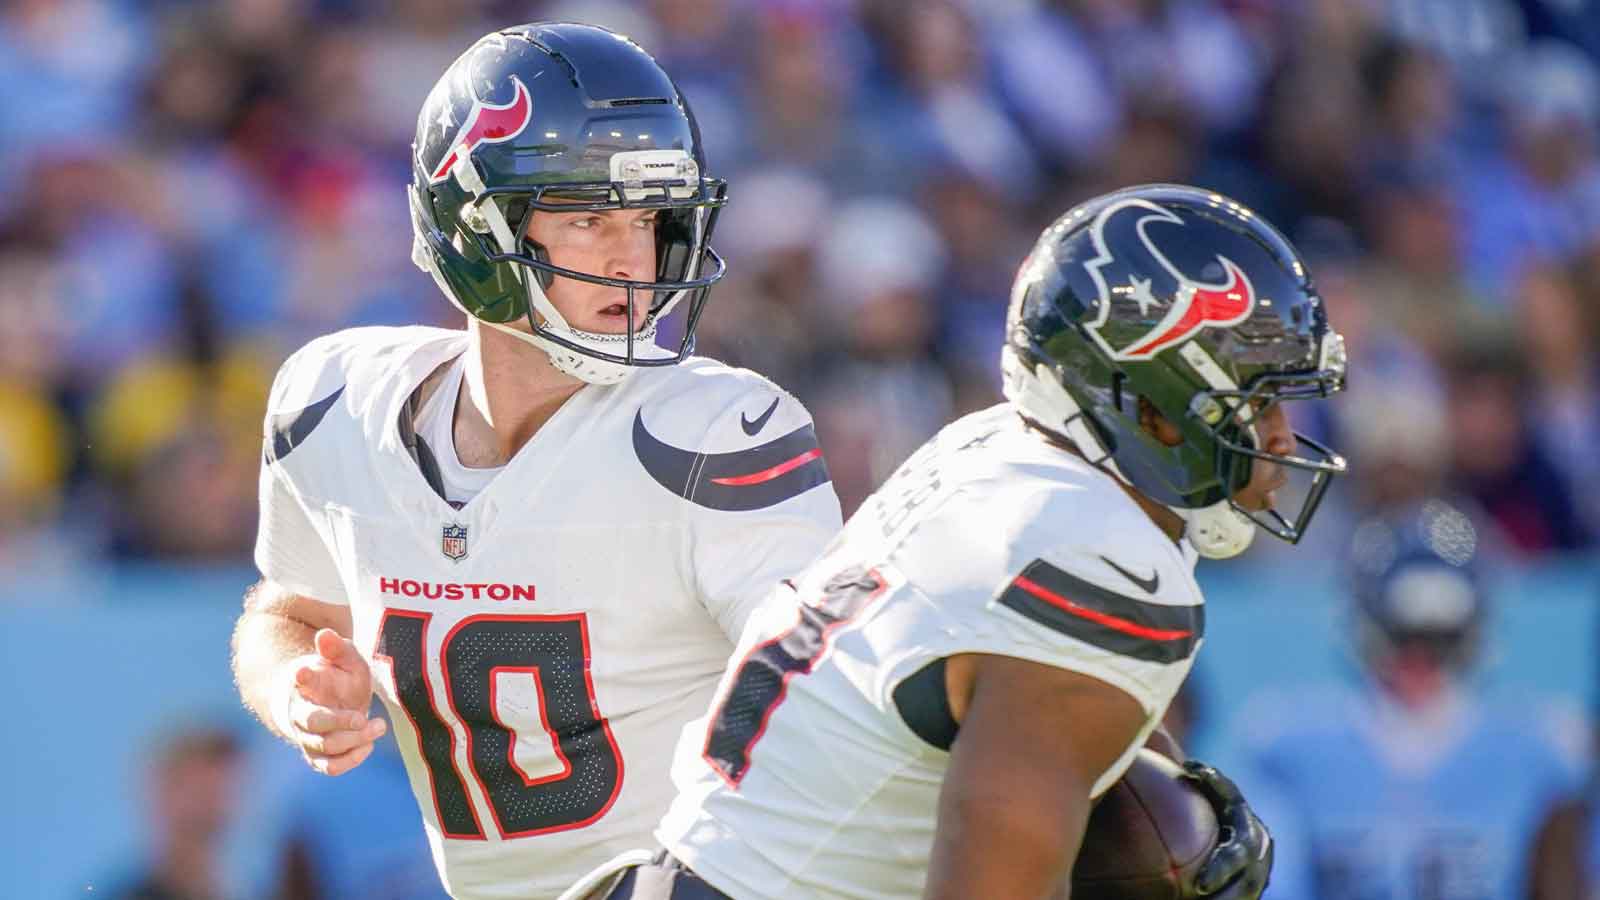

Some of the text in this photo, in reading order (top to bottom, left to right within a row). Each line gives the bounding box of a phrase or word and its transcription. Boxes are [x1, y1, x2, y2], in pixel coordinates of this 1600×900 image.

[445, 538, 465, 555] NFL
[380, 577, 536, 600] HOUSTON
[372, 607, 624, 841] 10
